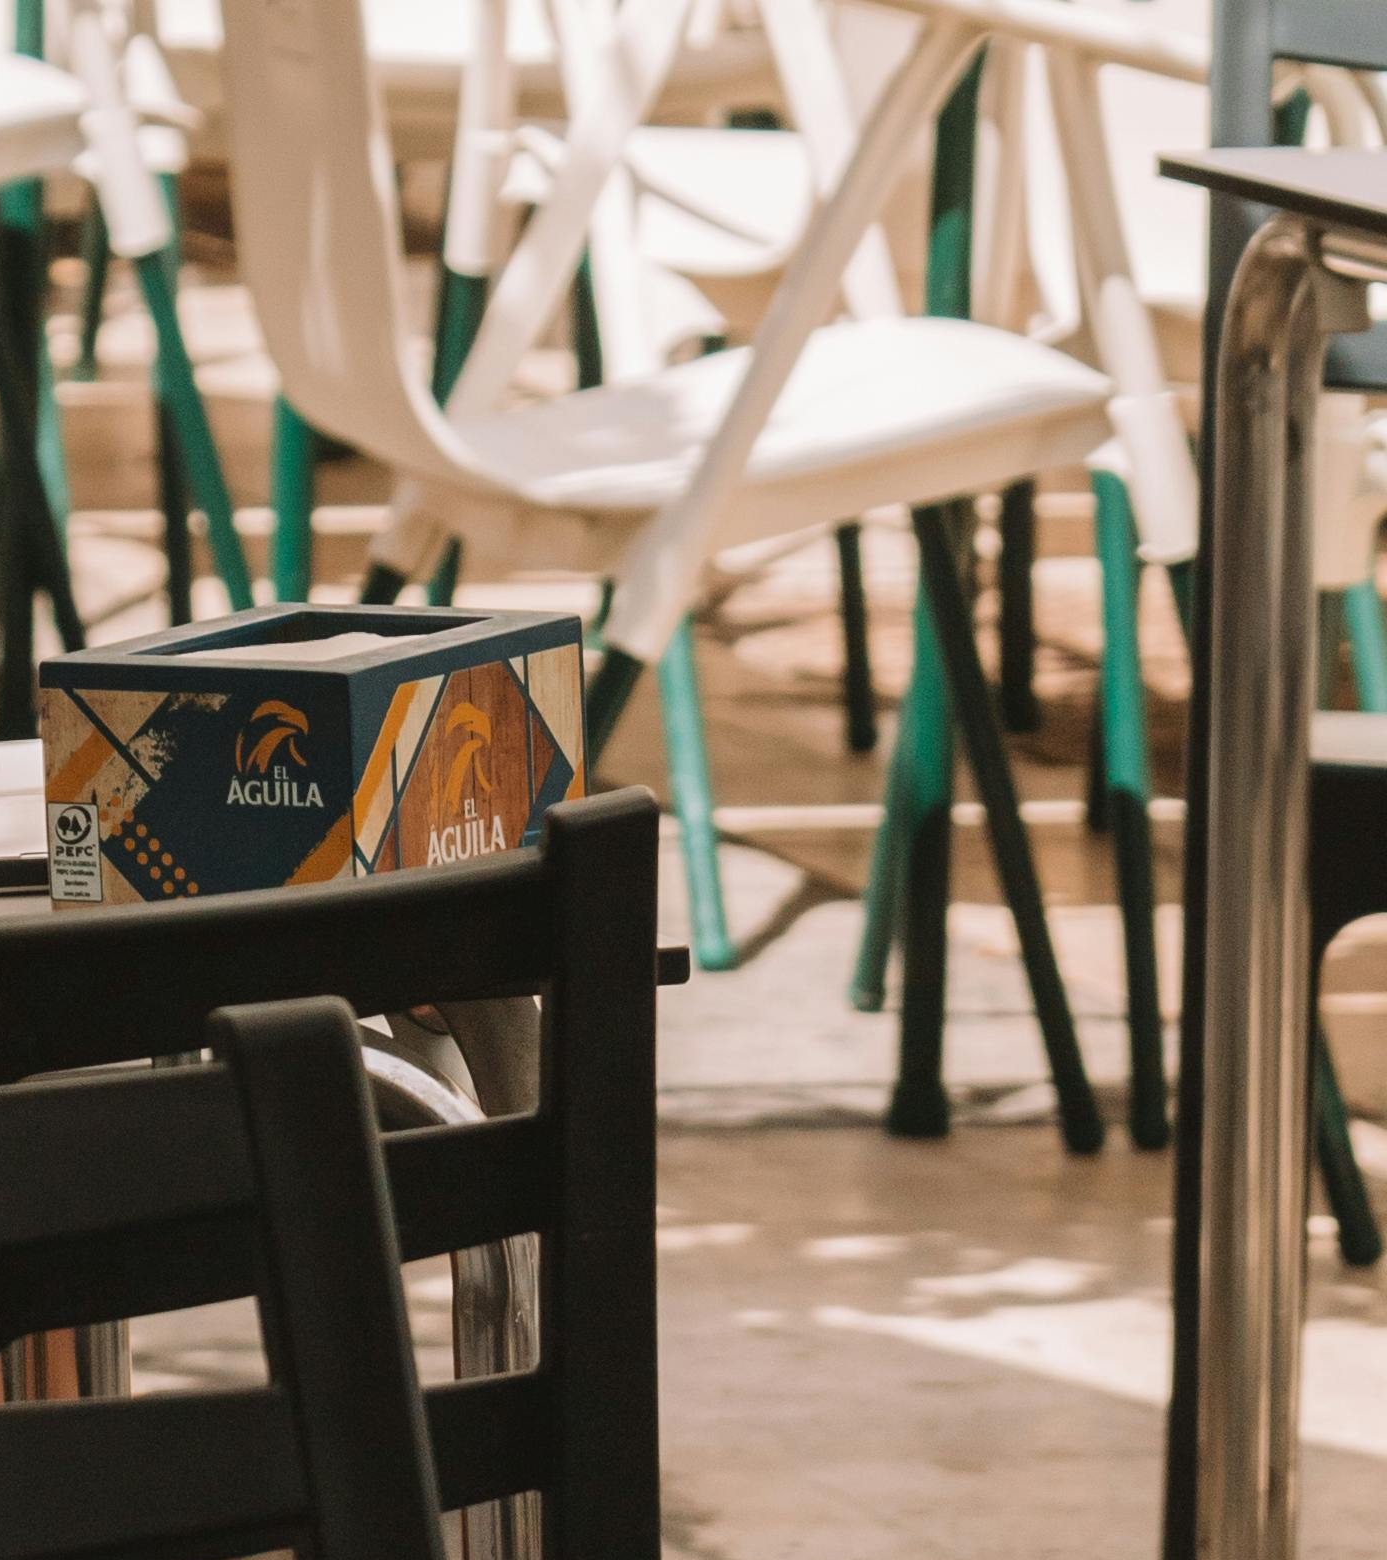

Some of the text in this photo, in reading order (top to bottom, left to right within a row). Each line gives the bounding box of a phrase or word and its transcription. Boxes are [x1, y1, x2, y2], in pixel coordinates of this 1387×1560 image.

[274, 765, 289, 780] EL
[227, 775, 324, 808] ÁGUILA
[464, 797, 478, 820] EL
[55, 845, 94, 857] PEFC
